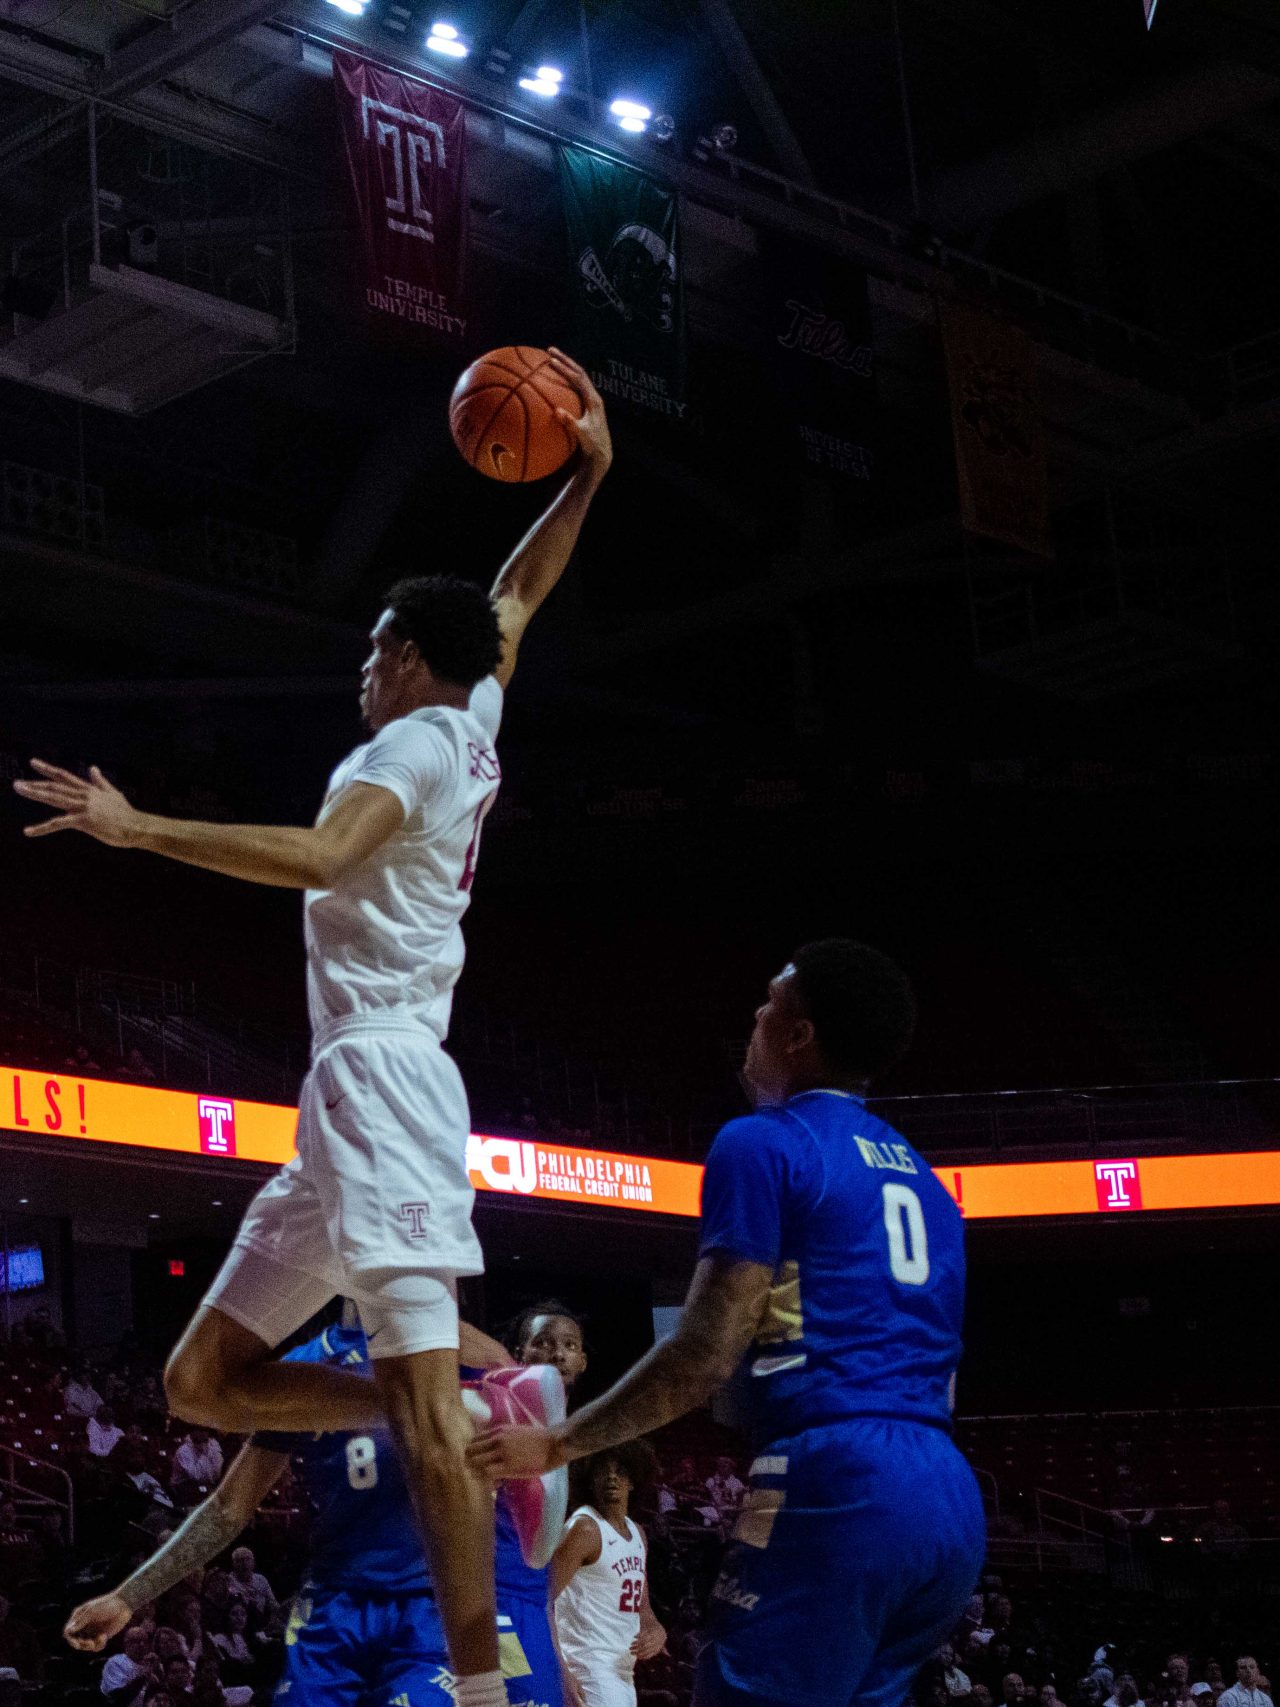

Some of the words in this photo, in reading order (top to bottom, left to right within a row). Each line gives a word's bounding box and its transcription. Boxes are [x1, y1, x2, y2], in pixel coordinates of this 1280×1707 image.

[384, 276, 449, 312] TEMPLE
[366, 288, 468, 337] UNIVERSITY
[608, 359, 668, 395] TULANE
[538, 1151, 651, 1186] PHILADELPHIA
[539, 1173, 582, 1194] FEDERAL
[585, 1180, 619, 1197] CREDIT
[622, 1185, 652, 1202] UNION
[882, 1182, 930, 1285] 0
[345, 1436, 379, 1491] 8
